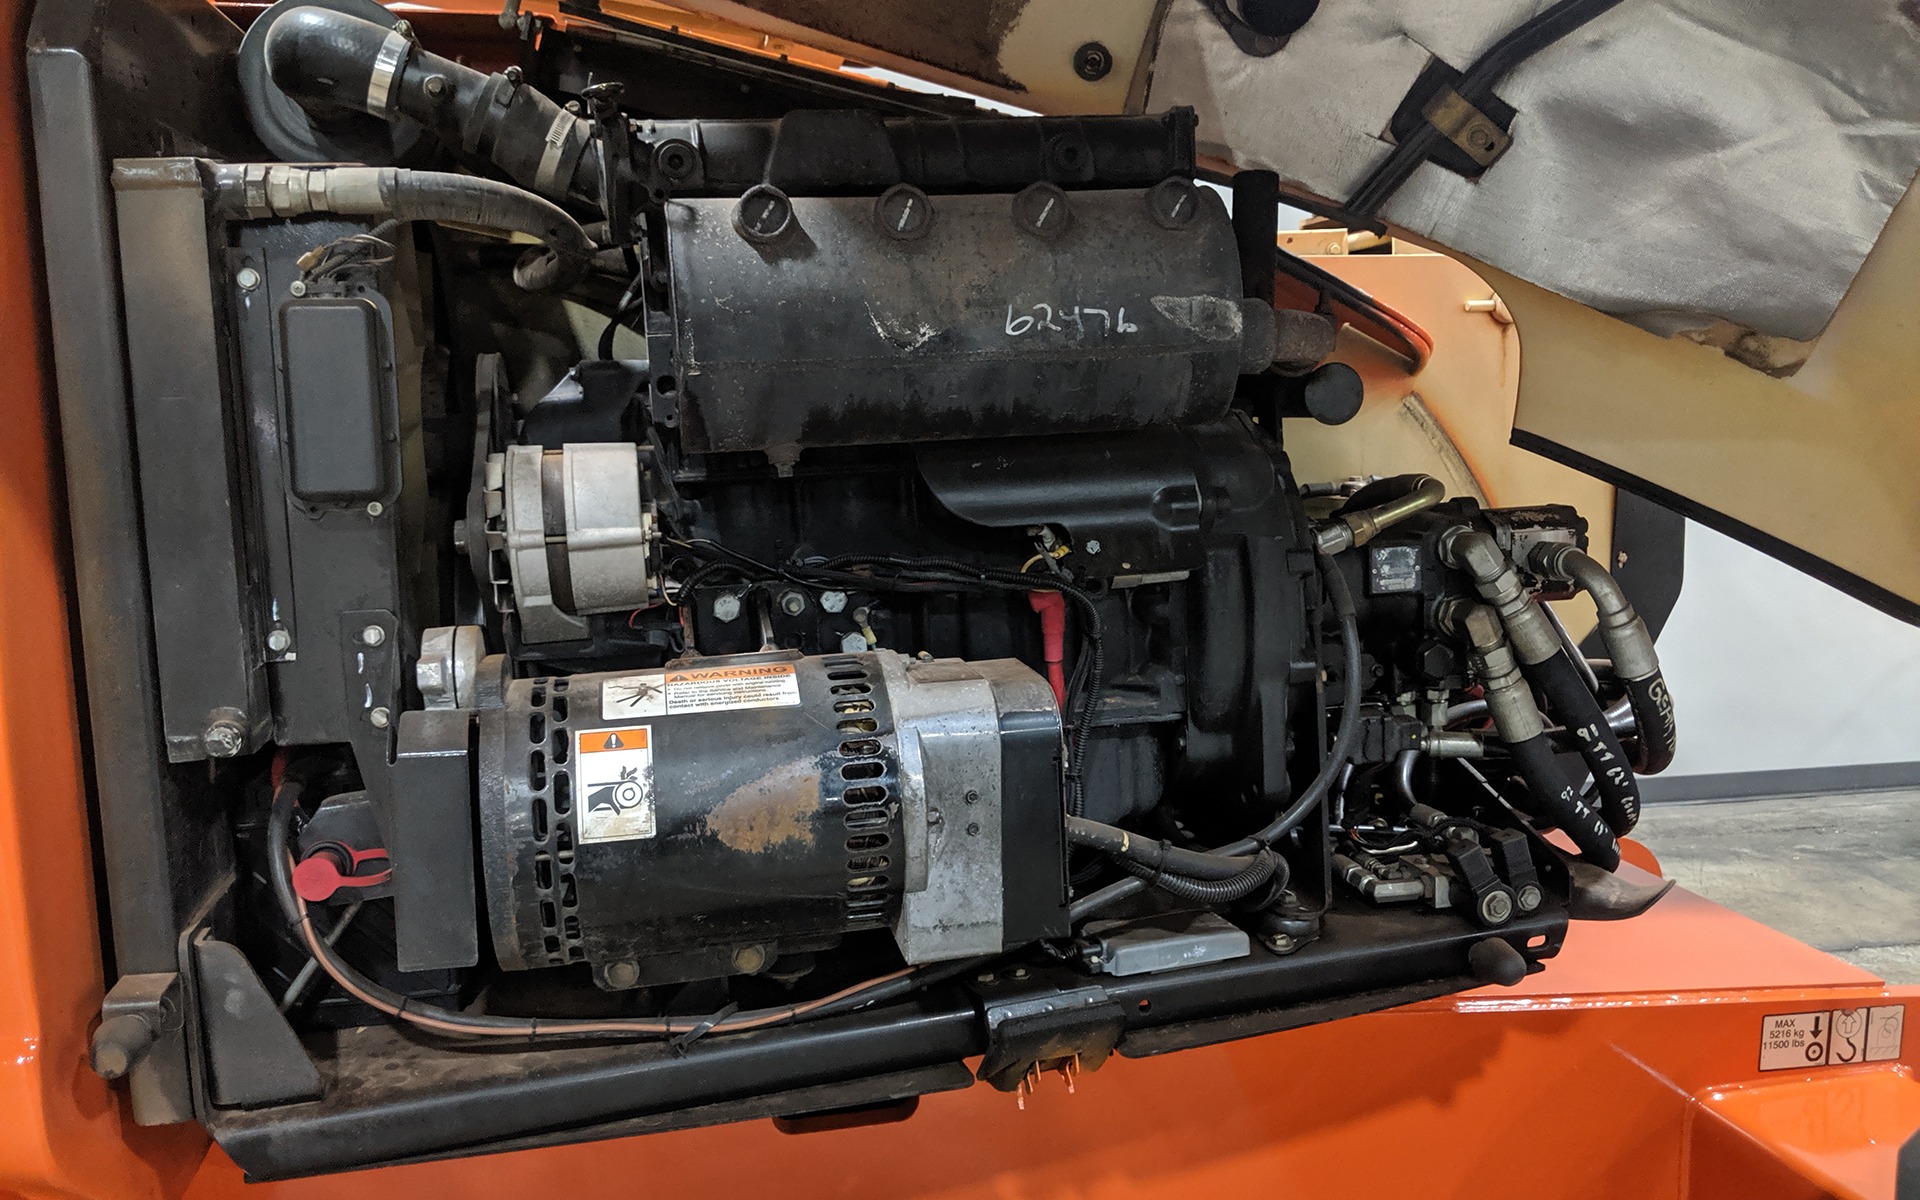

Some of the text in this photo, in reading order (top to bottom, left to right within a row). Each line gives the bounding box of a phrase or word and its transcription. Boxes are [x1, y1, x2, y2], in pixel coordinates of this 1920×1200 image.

[691, 666, 788, 679] WARNING
[710, 698, 742, 706] energized
[723, 693, 743, 701] injury
[1774, 1018, 1796, 1029] MAX
[1769, 1028, 1805, 1039] 5216 kg
[1763, 1039, 1805, 1050] 11500 lbs
